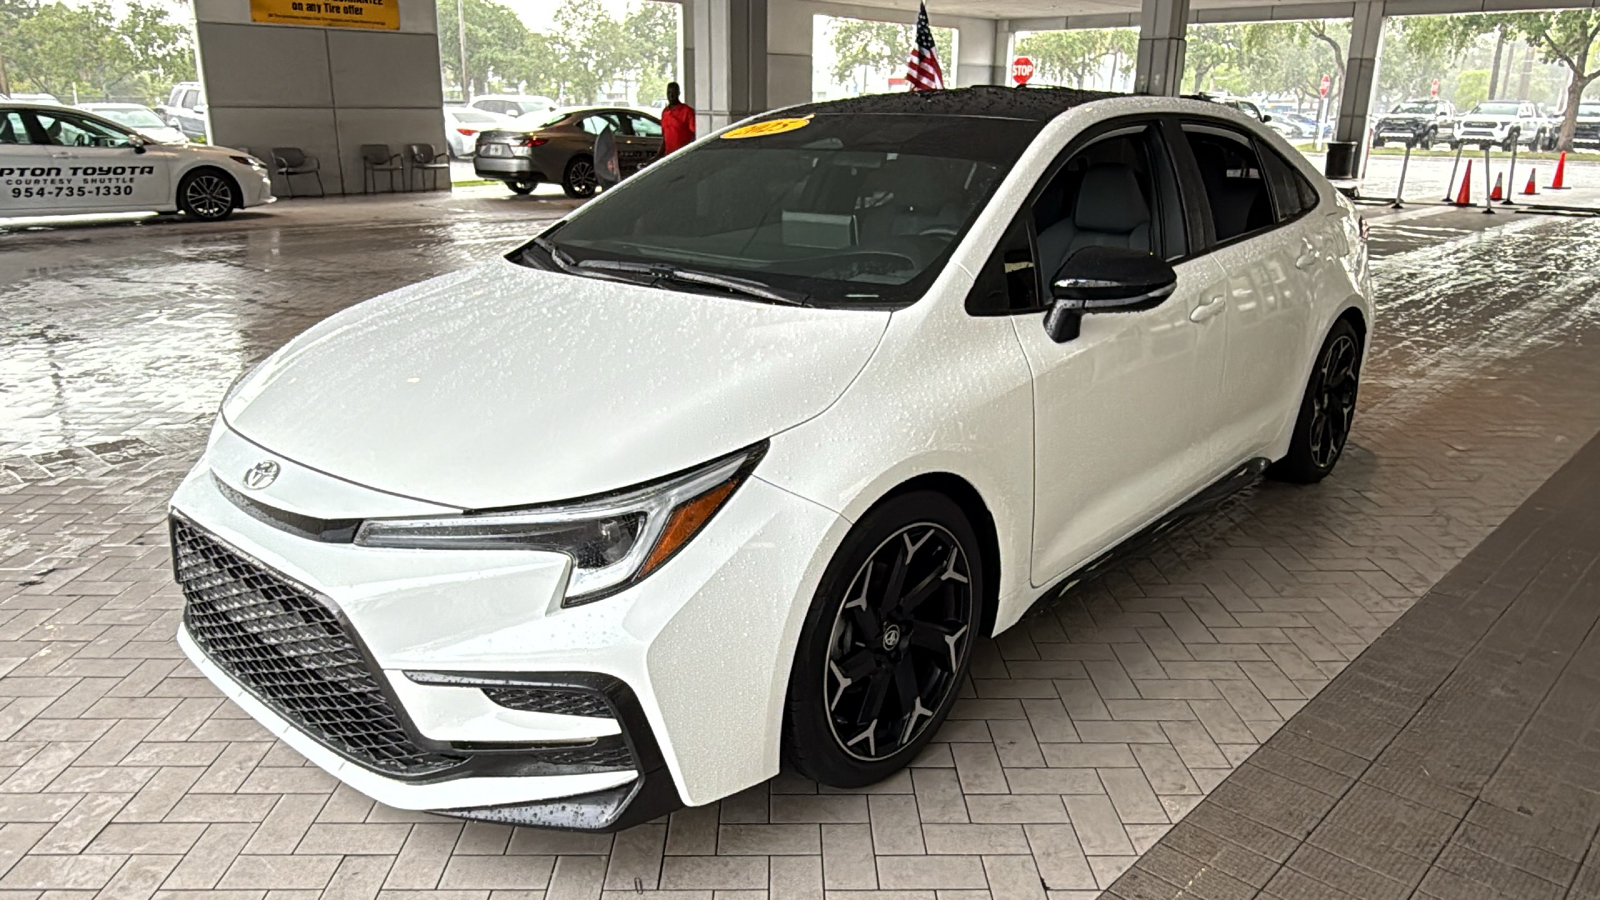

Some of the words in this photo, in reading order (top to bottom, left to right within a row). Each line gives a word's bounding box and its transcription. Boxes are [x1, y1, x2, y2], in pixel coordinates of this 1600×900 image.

[292, 2, 303, 11] on
[306, 3, 321, 13] any
[324, 3, 340, 14] Tire
[343, 5, 363, 15] offer
[1013, 65, 1033, 76] STOP
[0, 167, 62, 177] PTON
[69, 165, 154, 176] TOYOTA
[6, 178, 72, 186] COURTESY
[11, 185, 133, 198] 954-735-1330
